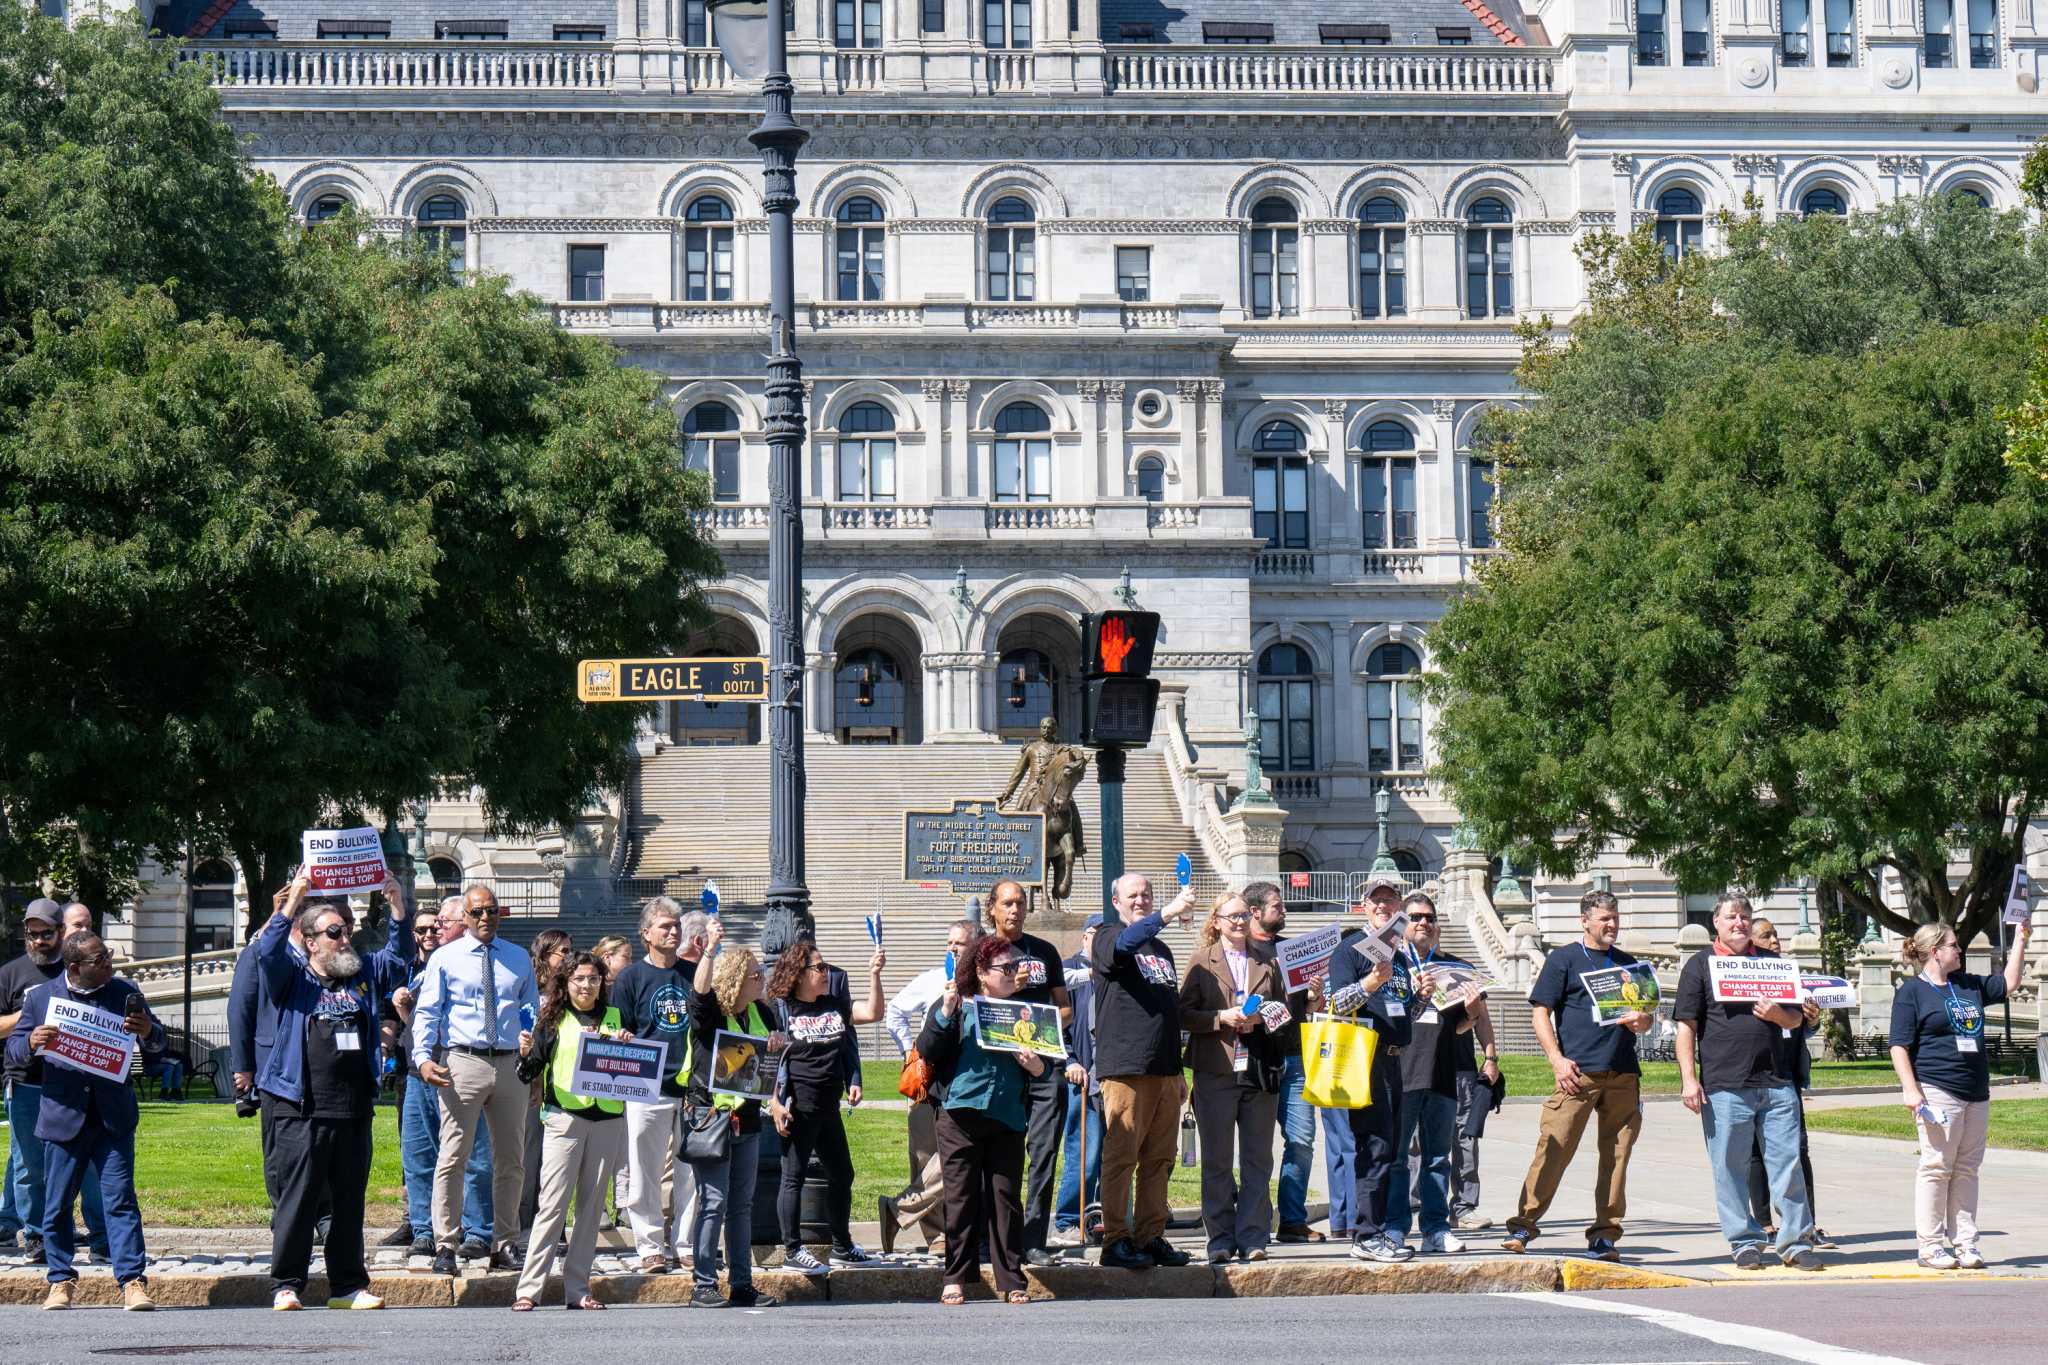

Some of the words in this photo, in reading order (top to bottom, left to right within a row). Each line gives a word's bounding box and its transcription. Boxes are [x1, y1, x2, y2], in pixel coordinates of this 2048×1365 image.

[631, 668, 702, 691] EAGLE
[732, 663, 746, 675] ST
[723, 681, 756, 693] 00171
[916, 821, 926, 829] IN
[945, 822, 972, 830] MIDDLE
[976, 822, 985, 830] OF
[988, 823, 1004, 831] THIS
[1007, 823, 1032, 832] STREET
[939, 831, 948, 839] TO
[968, 832, 985, 840] EAST
[989, 832, 1011, 840] STOOD
[310, 839, 334, 850] END
[337, 834, 377, 850] BULLYING
[930, 842, 956, 853] FORT
[961, 842, 1018, 854] FREDERICK
[317, 855, 352, 863] EMBRACE
[353, 851, 377, 860] RESPECT
[937, 855, 946, 863] OF
[996, 856, 1018, 864] DRIVE
[1023, 856, 1032, 864] TO
[313, 867, 353, 877] CHANGE
[355, 863, 382, 874] STARTS
[922, 865, 944, 873] SPLIT
[325, 877, 337, 887] AT
[339, 876, 356, 885] THE
[357, 874, 375, 884] TOP!
[1283, 941, 1307, 952] CHANGE
[1285, 945, 1320, 962] CHANGE
[1320, 937, 1338, 951] LIVES
[1299, 964, 1319, 975] REJECT
[1716, 961, 1738, 969] END
[1741, 961, 1793, 971] BULLYING
[1722, 983, 1759, 991] CHANGE
[657, 999, 673, 1007] FUND
[54, 1004, 79, 1018] END
[657, 1005, 688, 1015] FUTURE
[58, 1022, 93, 1039] EMBRACE
[93, 1032, 121, 1047] RESPECT
[56, 1034, 89, 1053] HANGE
[89, 1044, 122, 1062] STARTS
[587, 1042, 624, 1057] WORKPLACE
[56, 1044, 69, 1054] AT
[70, 1048, 87, 1061] THE
[88, 1053, 110, 1068] TOP!
[596, 1059, 609, 1069] NOT
[609, 1060, 640, 1073] BULLYING
[582, 1080, 593, 1090] WE
[593, 1082, 613, 1093] STAND
[614, 1083, 649, 1097] TOGETHER!
